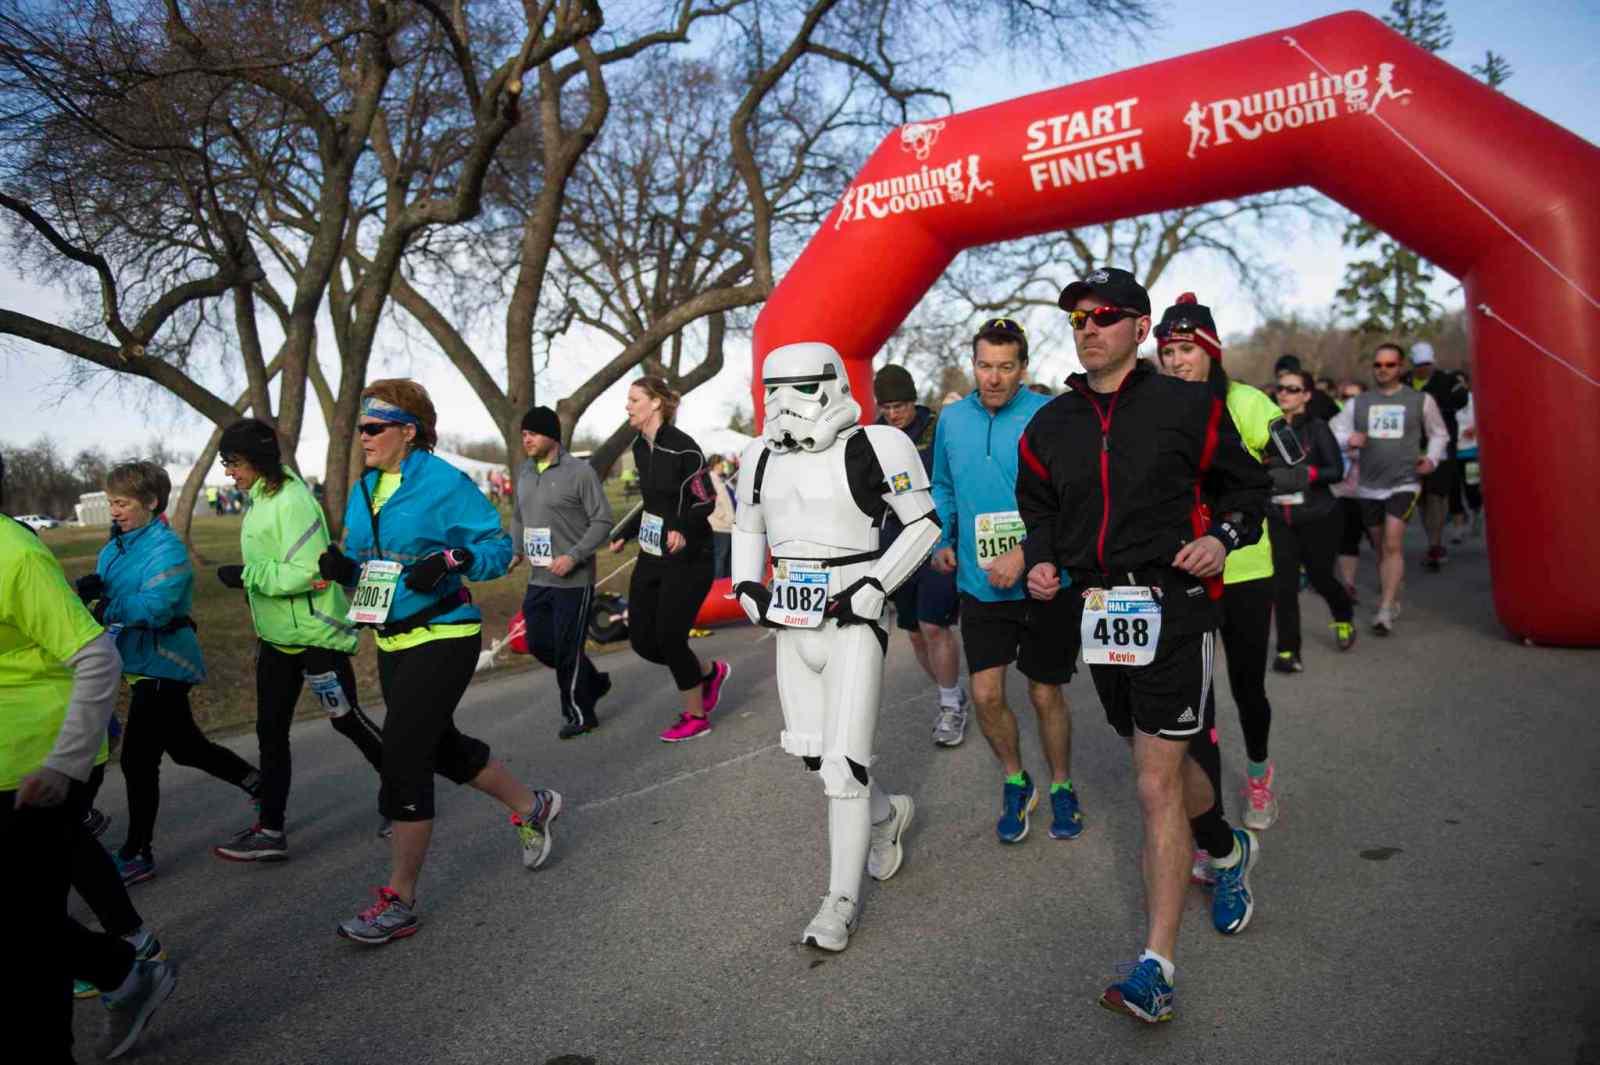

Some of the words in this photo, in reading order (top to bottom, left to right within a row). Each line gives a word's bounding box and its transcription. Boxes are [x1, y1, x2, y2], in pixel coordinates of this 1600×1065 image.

[1026, 97, 1139, 151] START
[1209, 65, 1368, 146] Running
[1029, 141, 1144, 191] FINISH
[853, 158, 964, 220] Running
[773, 585, 826, 612] 1082
[1108, 601, 1131, 612] HALF
[1093, 618, 1149, 647] 488
[1108, 651, 1137, 664] Kevin
